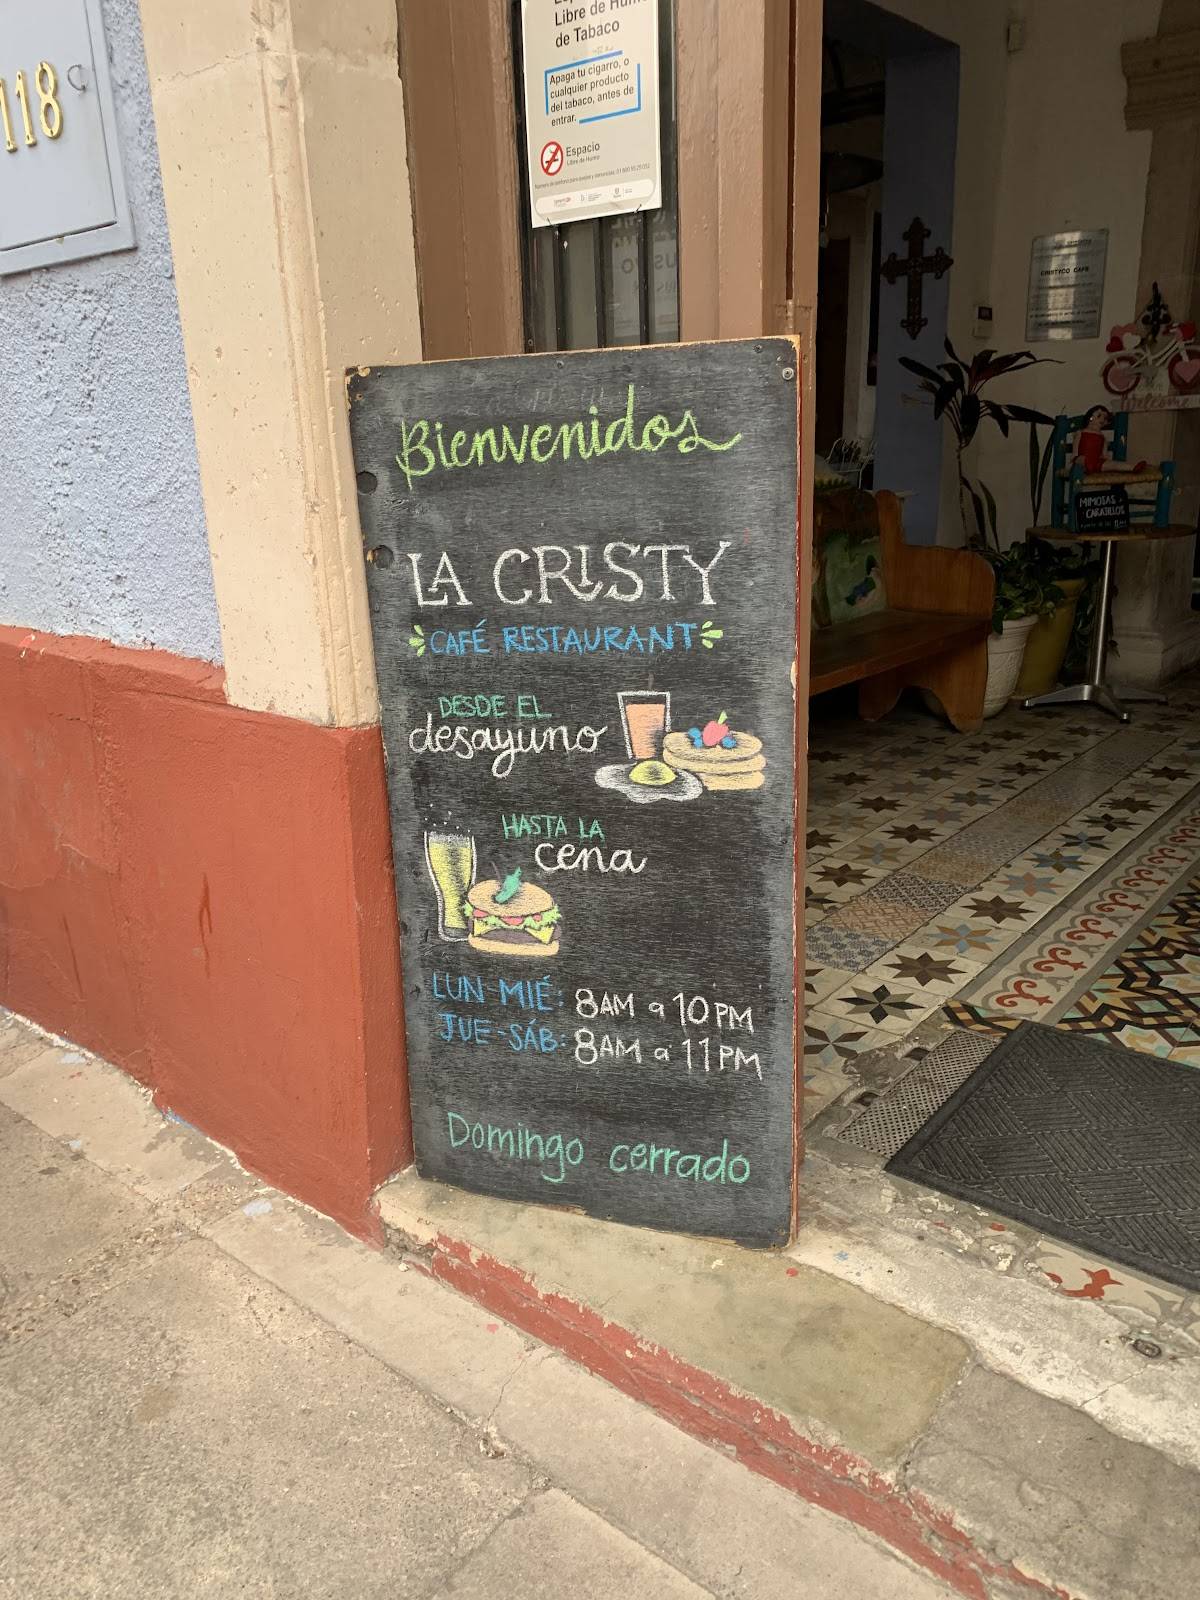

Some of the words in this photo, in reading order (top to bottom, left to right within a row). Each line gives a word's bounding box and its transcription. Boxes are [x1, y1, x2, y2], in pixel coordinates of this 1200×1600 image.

[555, 7, 586, 27] Libre
[590, 0, 606, 16] de
[555, 32, 570, 48] de
[574, 20, 620, 43] Tabaco
[550, 71, 576, 86] Apaga
[577, 67, 586, 79] tu
[588, 61, 622, 76] cigarro,
[623, 57, 630, 66] o
[550, 82, 588, 99] cualquier
[590, 72, 630, 92] producto
[0, 61, 63, 153] 118
[550, 101, 563, 113] del
[564, 94, 595, 109] tabaco,
[597, 89, 621, 103] antes
[623, 85, 635, 96] de
[551, 114, 577, 127] entrar.
[566, 141, 601, 158] Espacio
[395, 384, 742, 491] Bienvenidos
[1080, 495, 1117, 508] MIMOSAS
[406, 551, 473, 607] LA
[493, 540, 732, 606] CRISTY
[430, 619, 490, 656] CAFÉ
[502, 621, 698, 656] RESTAURANT
[439, 694, 506, 719] DESDE
[517, 694, 552, 719] EL
[408, 712, 608, 779] desayuno
[502, 813, 568, 841] HASTA
[579, 816, 606, 842] LA
[534, 842, 648, 875] cena
[648, 1002, 665, 1018] a
[654, 1046, 670, 1062] a
[447, 1110, 585, 1184] Domingo
[608, 1138, 751, 1185] cerrado
